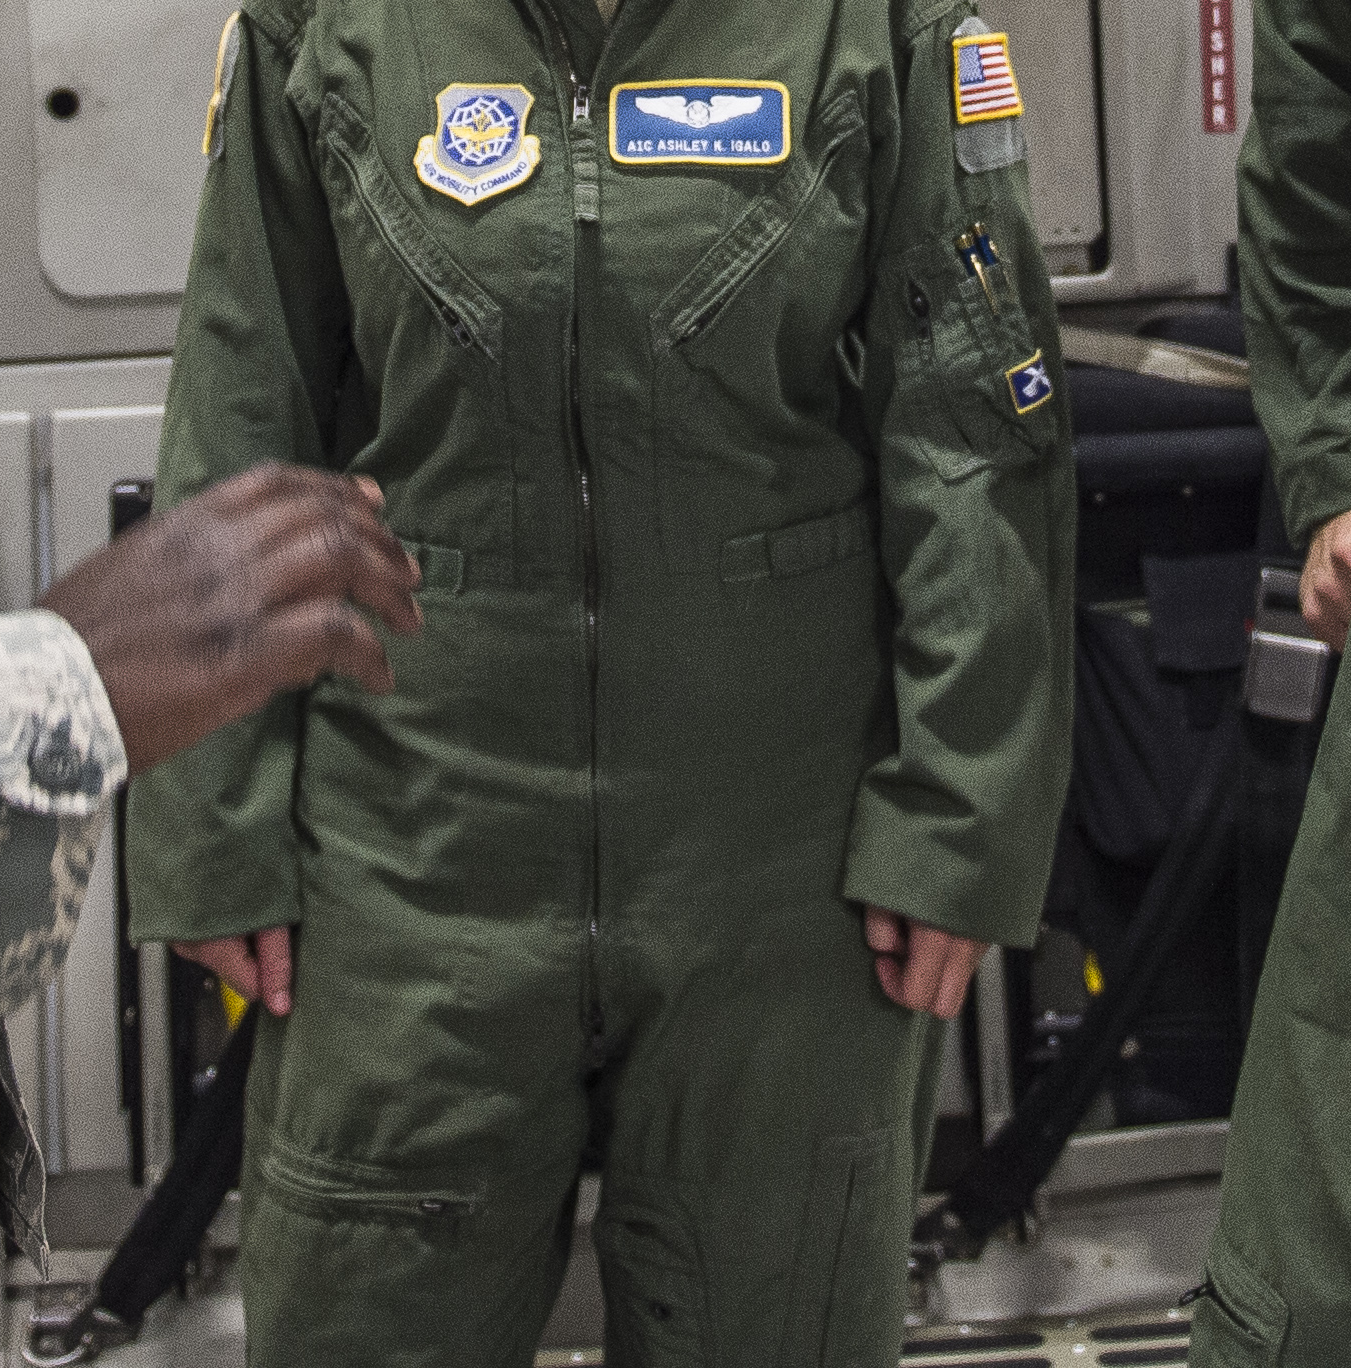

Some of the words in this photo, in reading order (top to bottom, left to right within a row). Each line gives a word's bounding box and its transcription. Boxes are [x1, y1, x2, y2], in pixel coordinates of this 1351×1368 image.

[657, 139, 709, 152] ASHLEY
[730, 139, 771, 153] IGALO
[436, 174, 479, 195] MOBILITY
[480, 160, 528, 192] COMMAND
